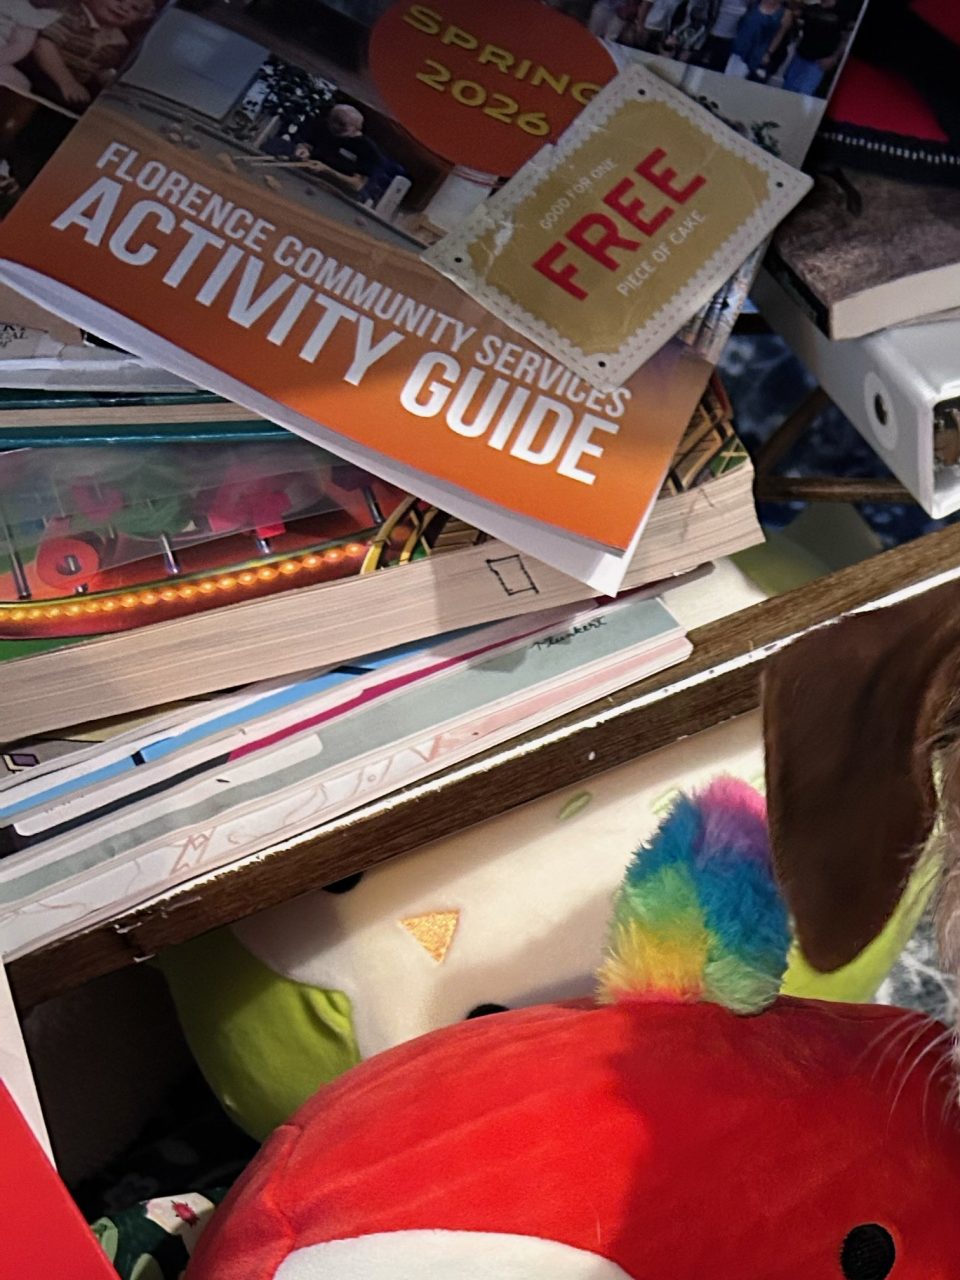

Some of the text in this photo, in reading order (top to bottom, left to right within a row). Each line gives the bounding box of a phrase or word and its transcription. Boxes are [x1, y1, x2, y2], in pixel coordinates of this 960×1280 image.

[416, 59, 550, 136] 2026
[532, 147, 706, 301] FREE
[540, 158, 618, 230] GOOD FOR ONE
[616, 209, 706, 297] PIECE OF CAKE
[51, 176, 621, 485] ACTIVITY GUIDE
[96, 141, 632, 419] FLORENCE COMMUNITY SERVICES
